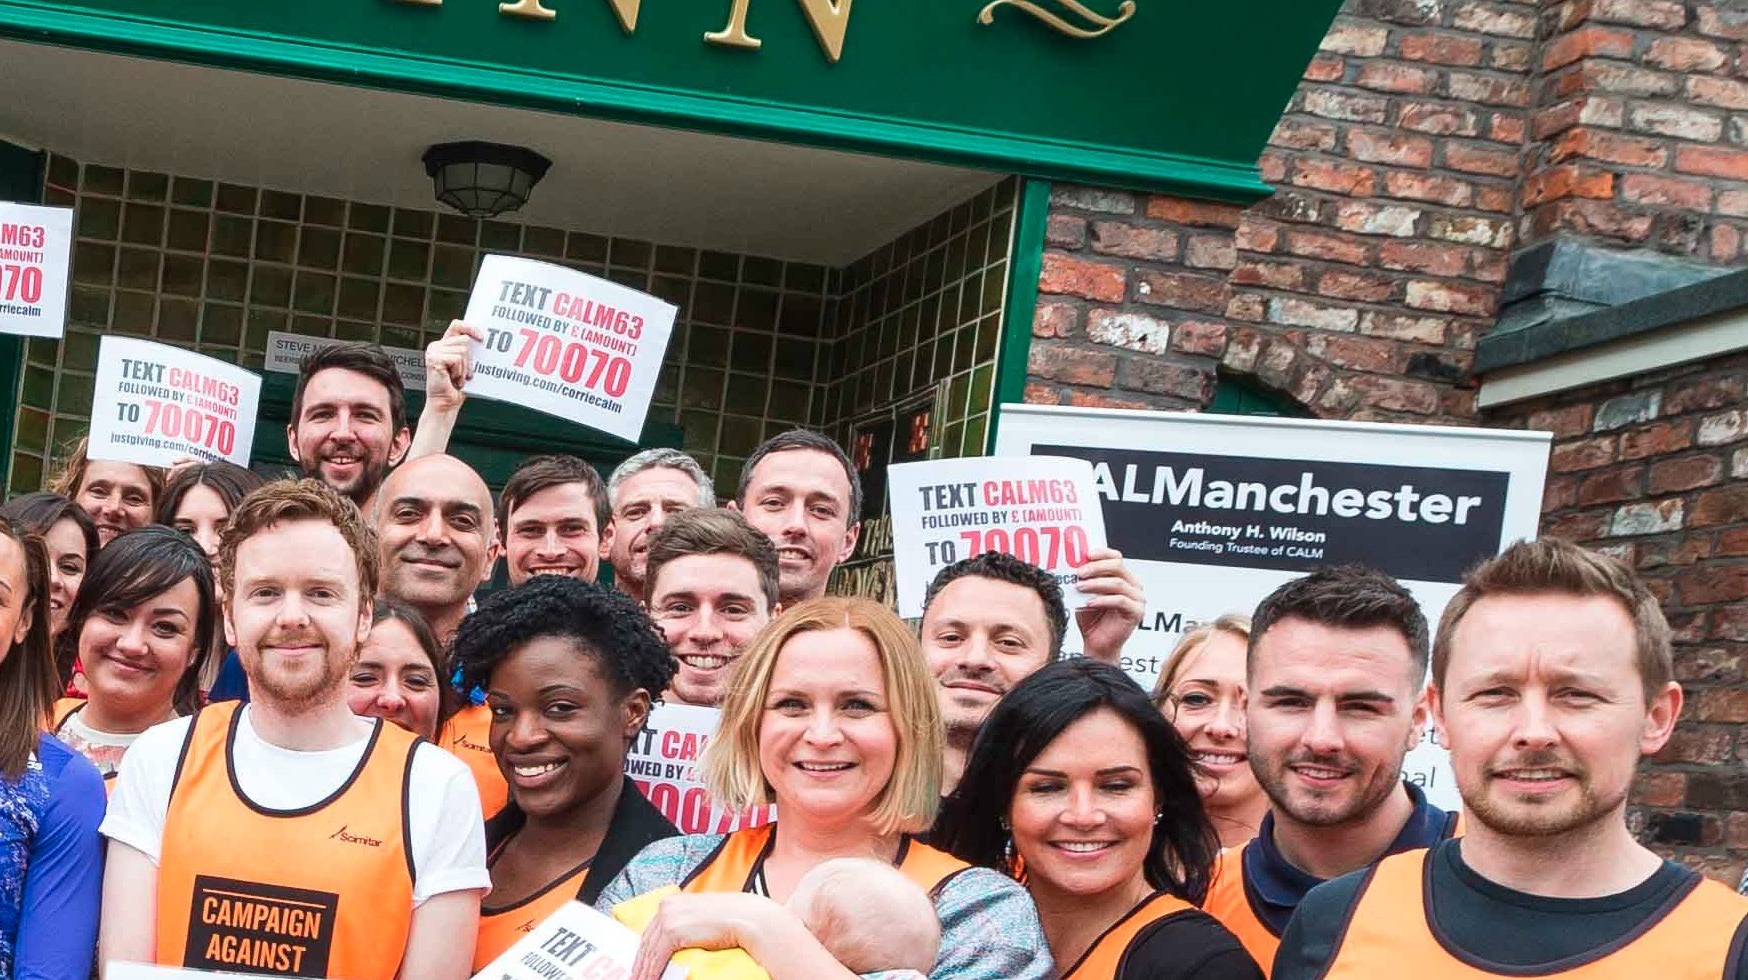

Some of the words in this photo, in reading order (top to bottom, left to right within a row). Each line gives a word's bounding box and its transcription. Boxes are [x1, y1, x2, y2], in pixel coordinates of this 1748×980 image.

[491, 305, 552, 330] FOLLOWED
[552, 319, 570, 335] BY
[498, 280, 553, 311] TEXT
[553, 292, 644, 341] CALM63
[485, 327, 514, 353] TO
[513, 328, 632, 398] 70070
[118, 380, 170, 399] FOLLOWED
[171, 390, 185, 403] BY
[121, 358, 167, 384] TEXT
[168, 367, 240, 407] CALM63
[473, 361, 623, 414] justgiving.com/corriecalm
[116, 401, 140, 423] TO
[144, 400, 236, 456] 70070
[919, 483, 977, 511] TEXT
[983, 480, 1078, 506] CALM63
[1094, 463, 1481, 525] ALManchester
[922, 512, 988, 529] FOLLOWED
[993, 511, 1008, 523] BY
[1171, 519, 1243, 540] Anthony
[1247, 524, 1264, 540] H.
[1269, 526, 1326, 543] Wilson
[925, 540, 956, 565] TO
[1169, 538, 1225, 556] Founding
[1226, 541, 1269, 556] Trustee
[1272, 544, 1284, 556] of
[1286, 546, 1324, 559] CALM
[340, 831, 383, 847] Scimitar
[202, 896, 322, 940] CAMPAIGN
[205, 933, 307, 973] AGAINST
